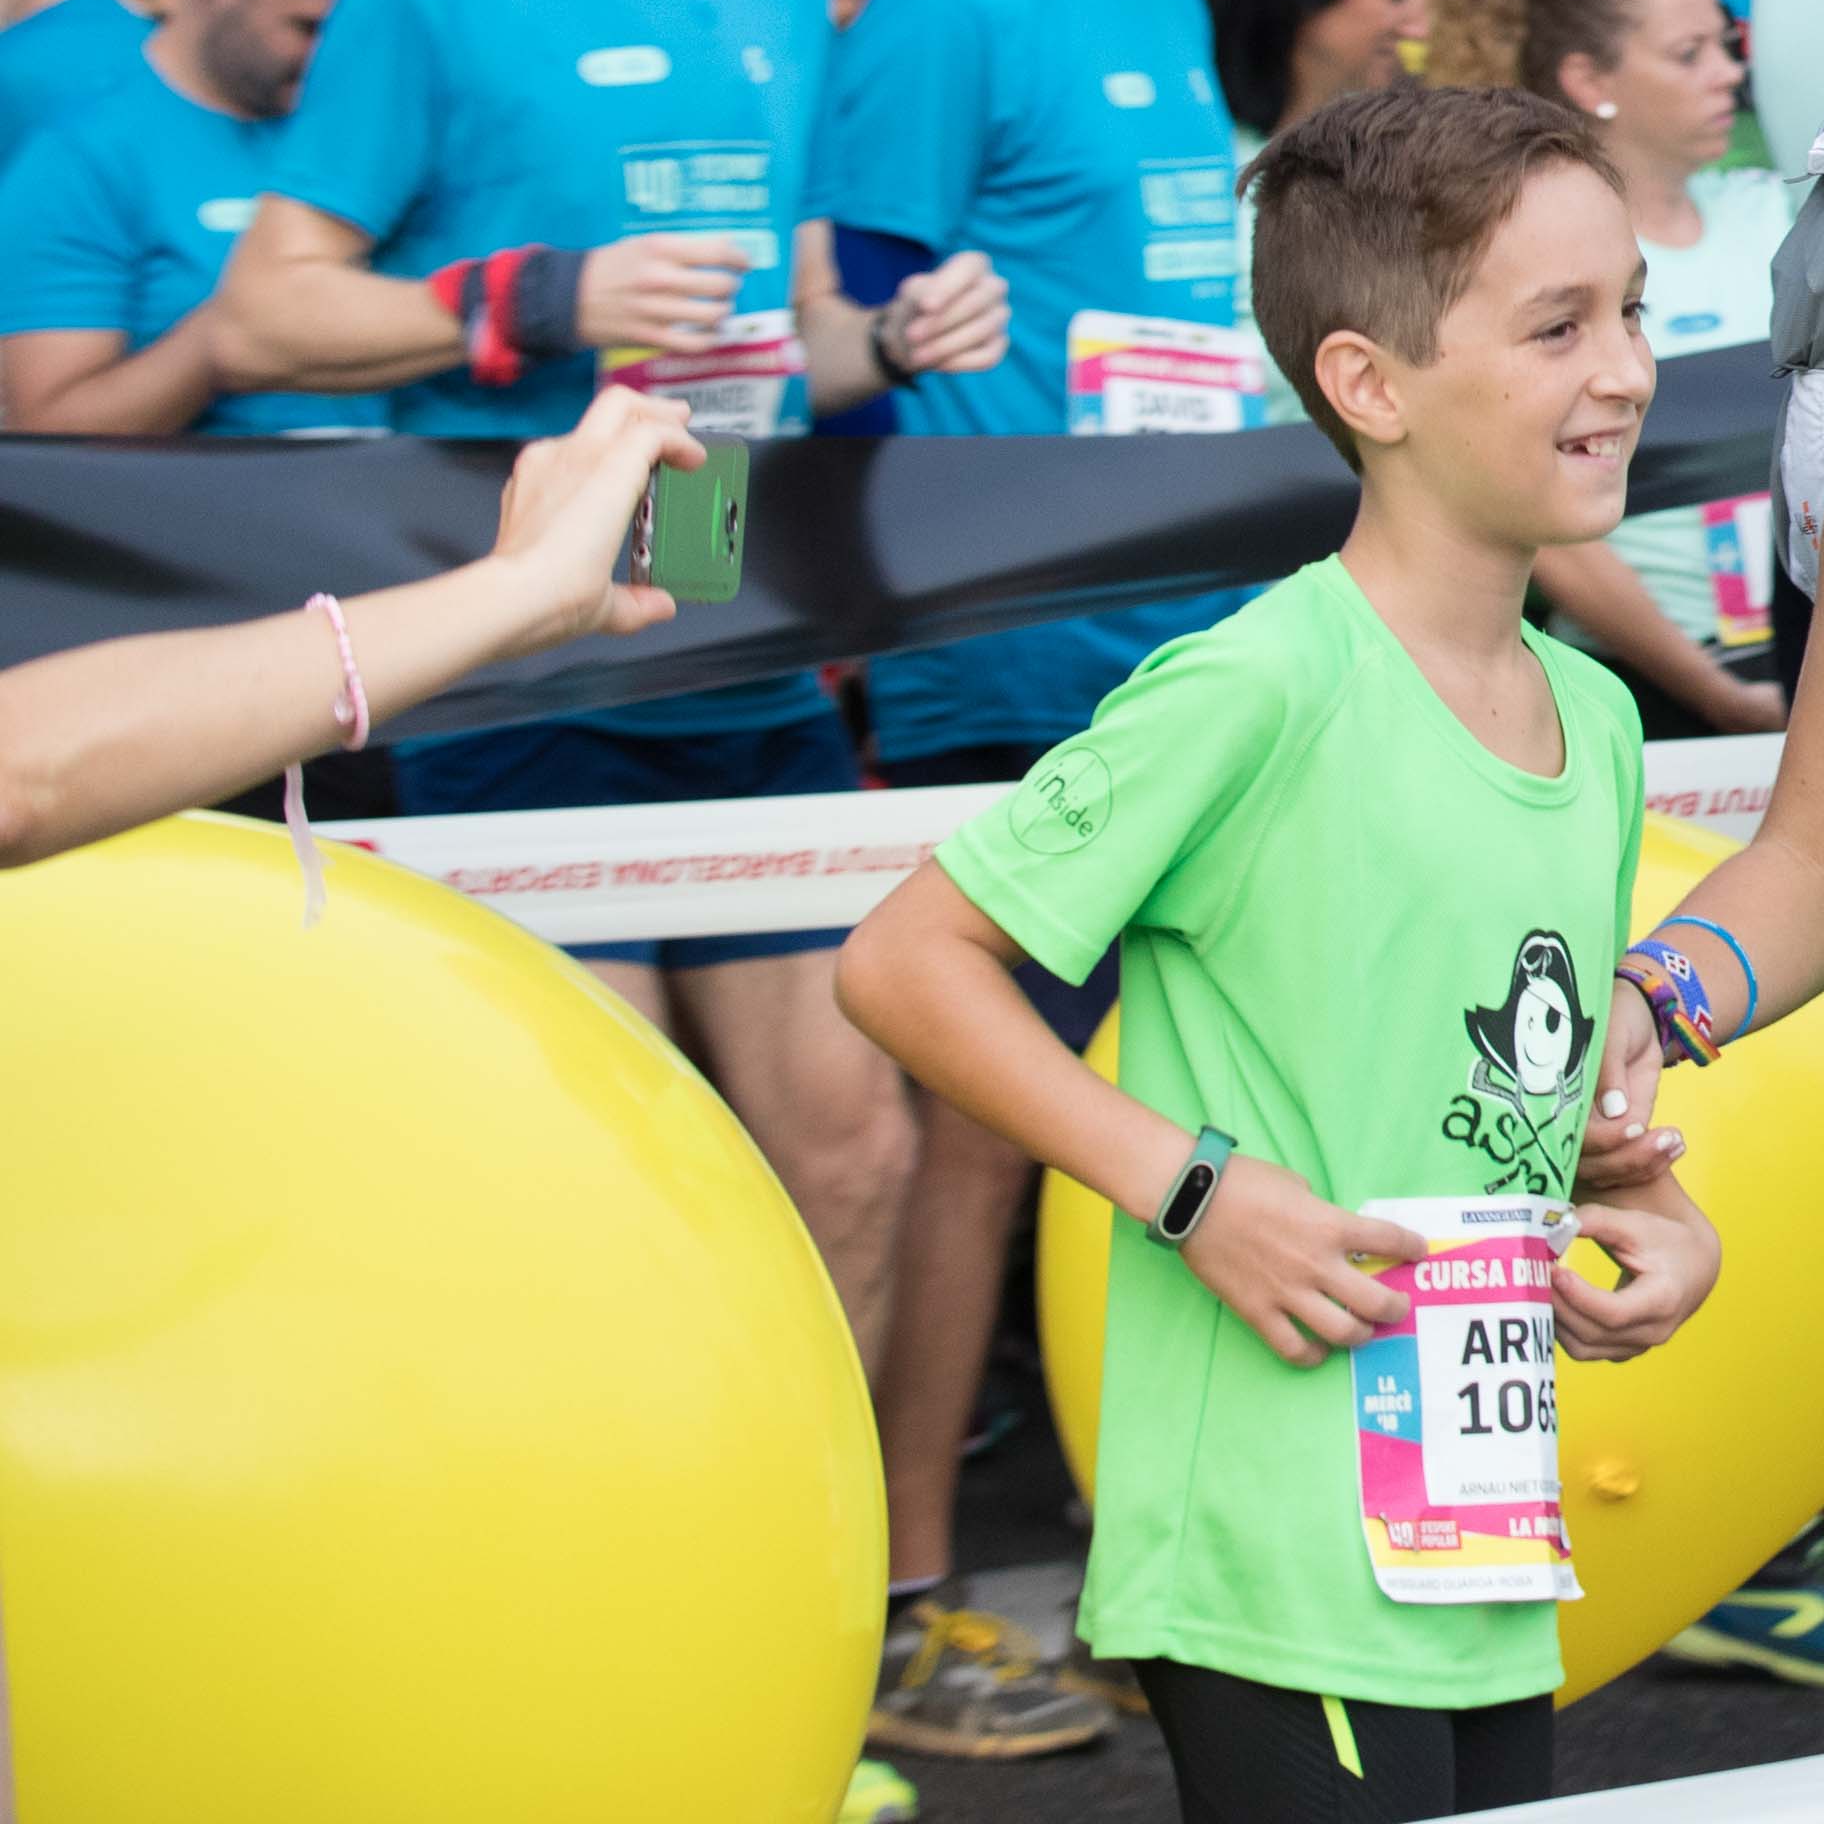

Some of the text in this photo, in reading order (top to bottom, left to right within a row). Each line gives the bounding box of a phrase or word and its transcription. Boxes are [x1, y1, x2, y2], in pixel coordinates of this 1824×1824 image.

[1414, 1257, 1508, 1292] CURSA
[1460, 1317, 1554, 1366] ARNA
[1508, 1517, 1532, 1537] LA
